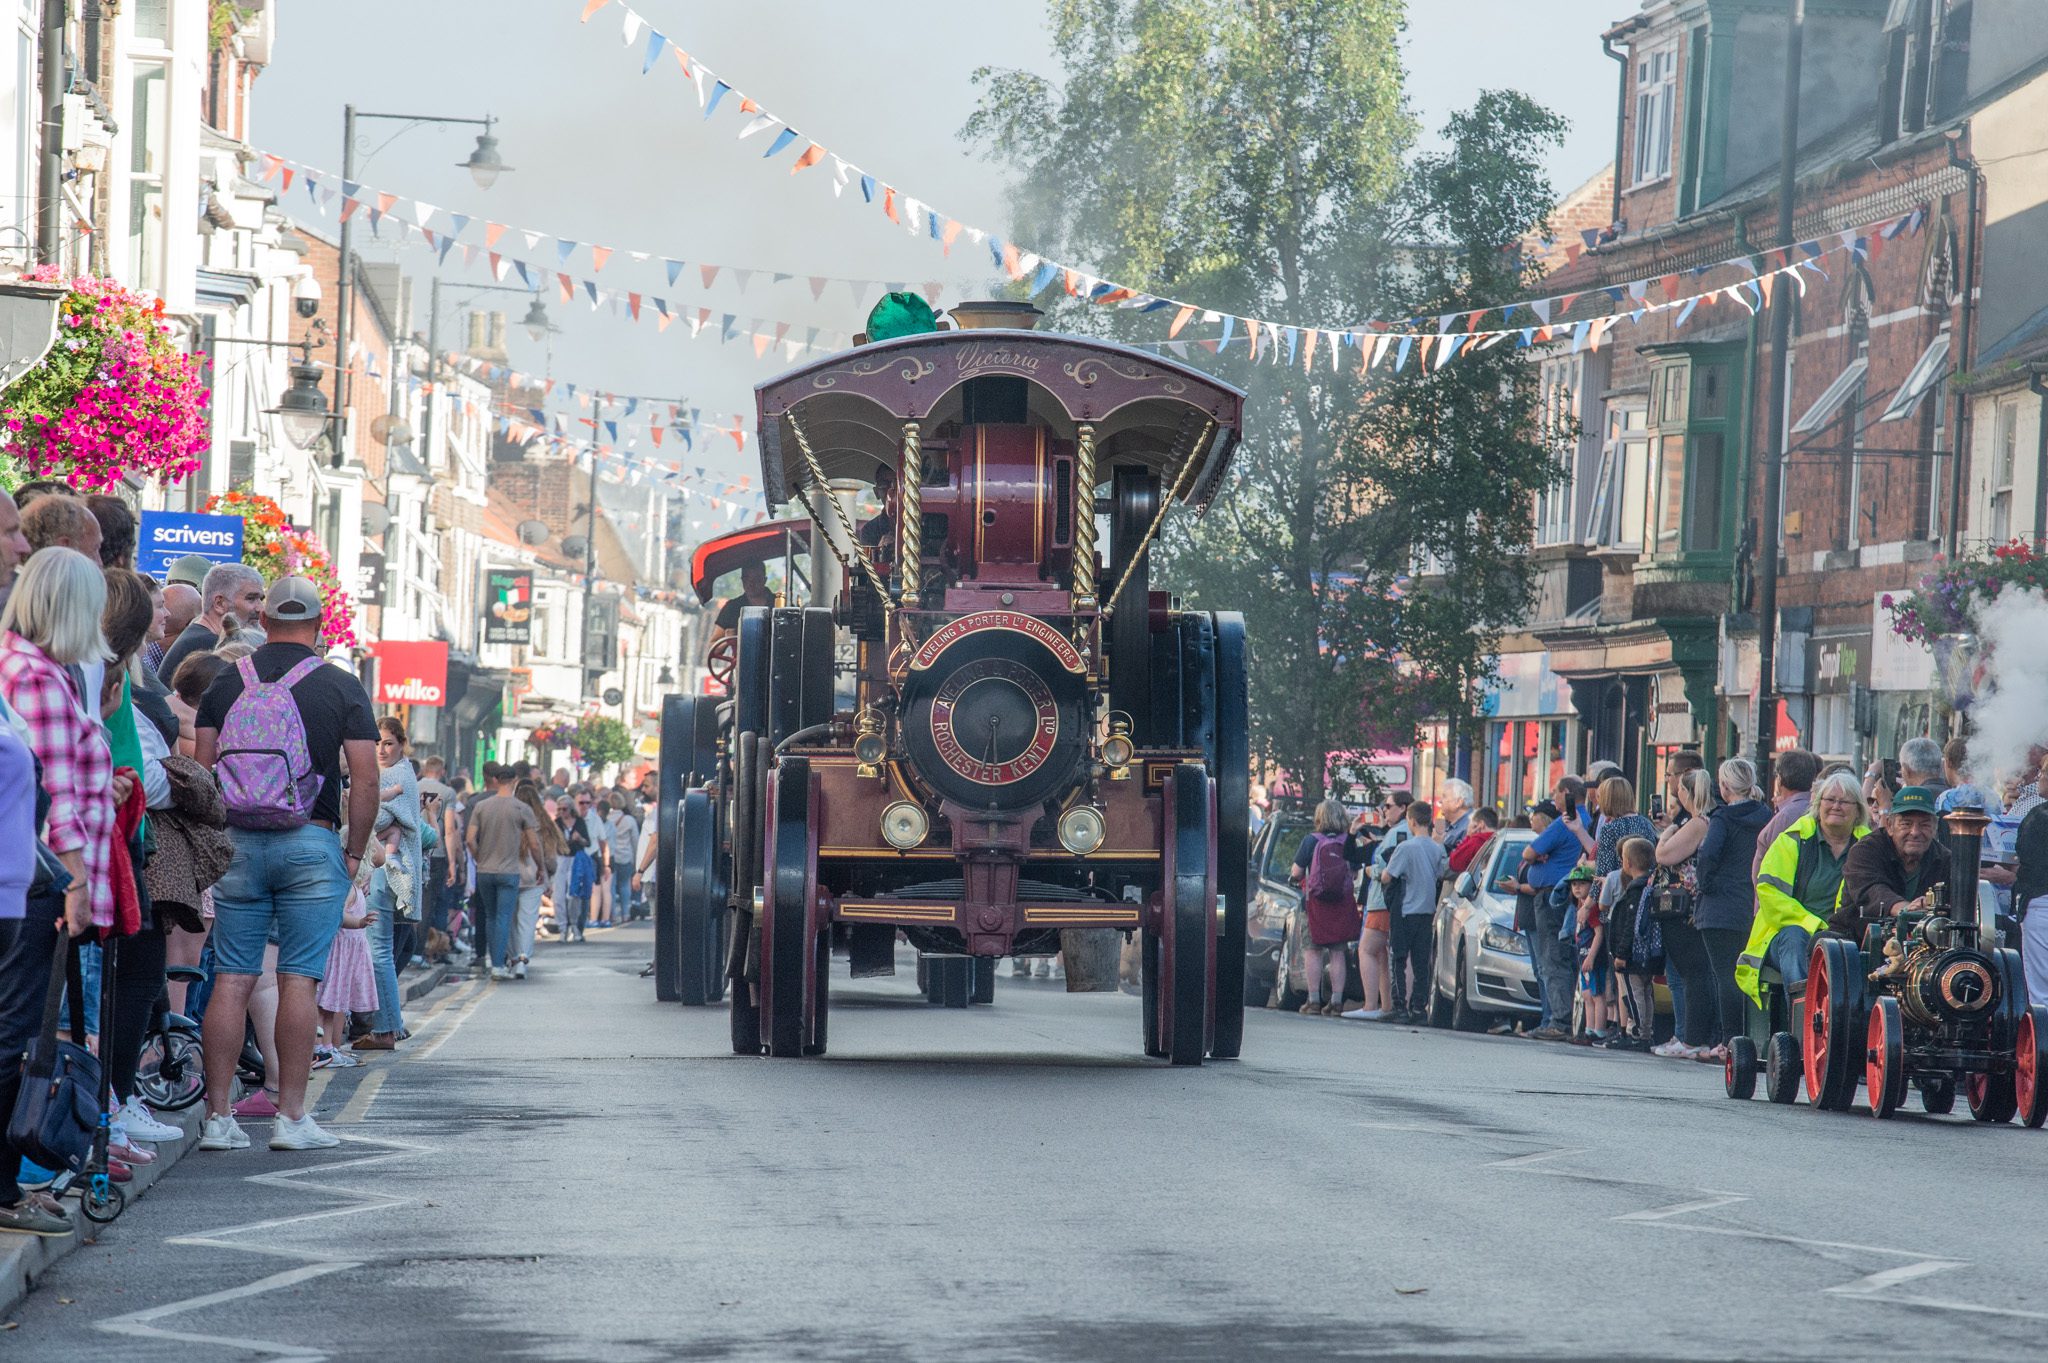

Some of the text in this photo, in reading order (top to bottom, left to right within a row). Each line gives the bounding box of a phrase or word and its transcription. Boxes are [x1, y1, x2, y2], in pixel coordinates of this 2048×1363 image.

[955, 341, 1040, 371] Victoria
[153, 525, 234, 546] scrivens
[922, 628, 957, 661] AVELING
[959, 623, 967, 632] &
[968, 615, 1009, 627] PORTER
[1025, 621, 1076, 663] ENGINEERS
[384, 678, 440, 701] wilko
[937, 664, 985, 710] AVELING
[1008, 665, 1052, 710] PORTER
[934, 721, 1048, 782] ROCHESTER KENT
